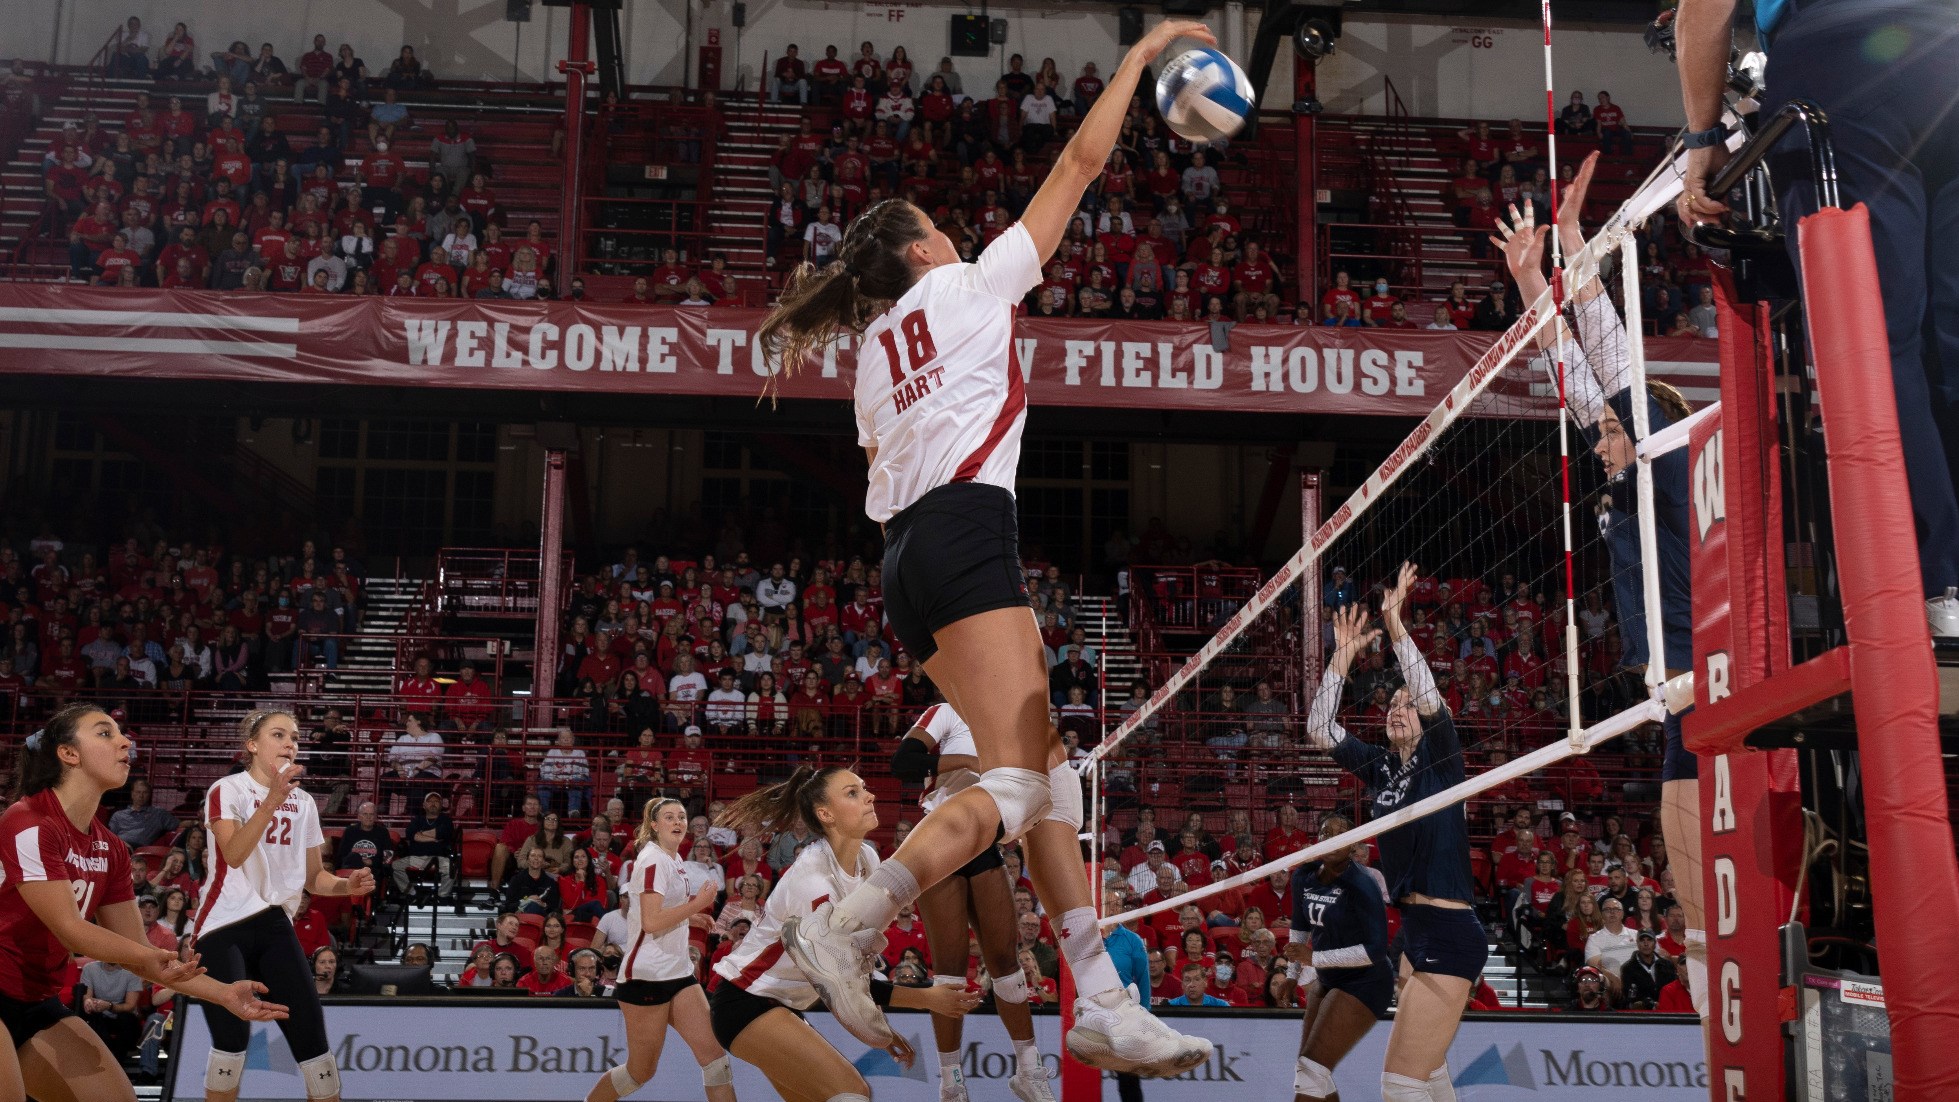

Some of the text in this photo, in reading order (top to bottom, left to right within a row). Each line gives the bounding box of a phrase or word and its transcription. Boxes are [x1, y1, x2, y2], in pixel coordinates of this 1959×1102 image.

[888, 9, 905, 21] FF
[1472, 36, 1493, 48] GG
[404, 319, 677, 373] WELCOME
[1064, 340, 1224, 389] FIELD
[1250, 345, 1425, 396] HOUSE
[878, 309, 938, 389] 18
[892, 366, 945, 415] HART
[1694, 429, 1726, 543] W
[266, 816, 292, 845] 22
[72, 879, 95, 920] 21
[1308, 902, 1326, 926] 17
[1319, 895, 1337, 903] STATE
[1845, 990, 1864, 998] MOBILE
[505, 1034, 627, 1073] Bank
[1539, 1049, 1709, 1088] Monona
